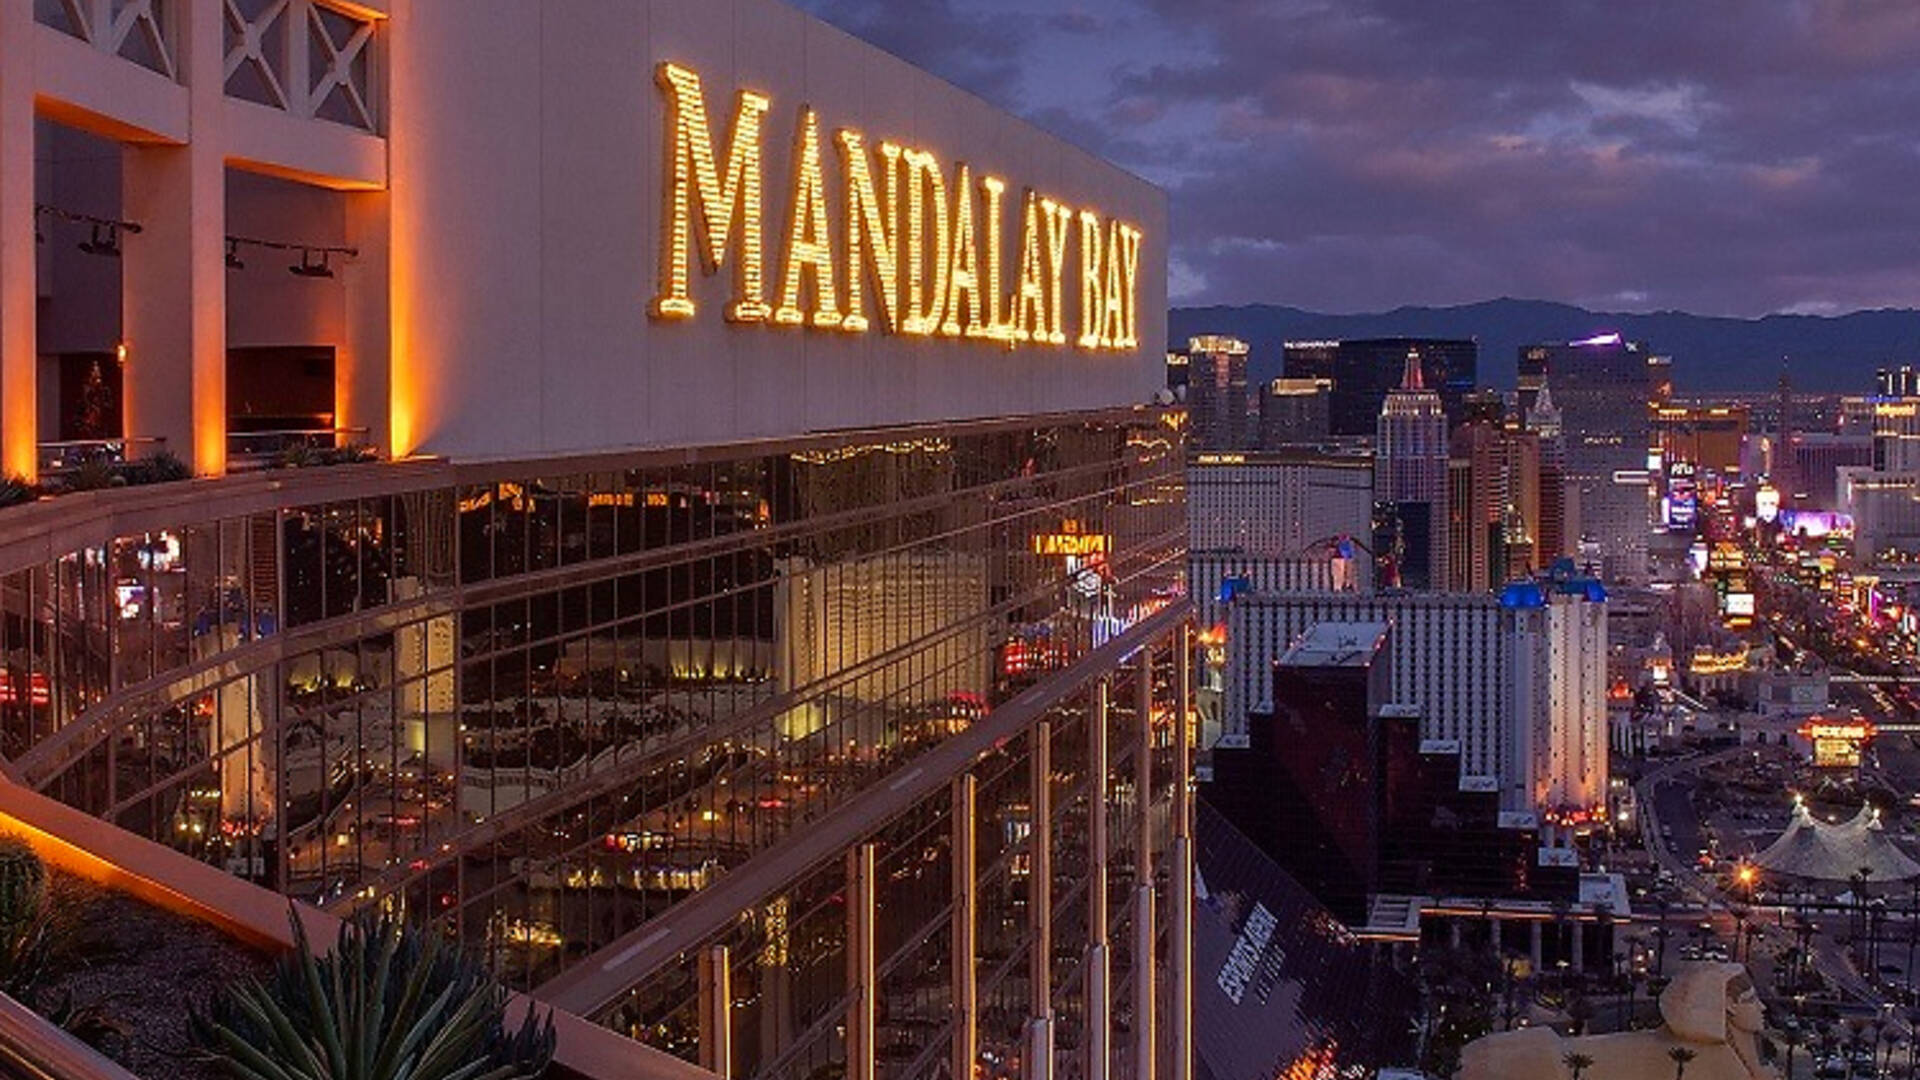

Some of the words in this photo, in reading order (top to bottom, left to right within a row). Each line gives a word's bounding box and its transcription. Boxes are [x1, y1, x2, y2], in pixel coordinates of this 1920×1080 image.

[654, 61, 1073, 347] MANDALAY
[1078, 207, 1143, 349] BAY
[1217, 934, 1261, 1005] ESPORTS
